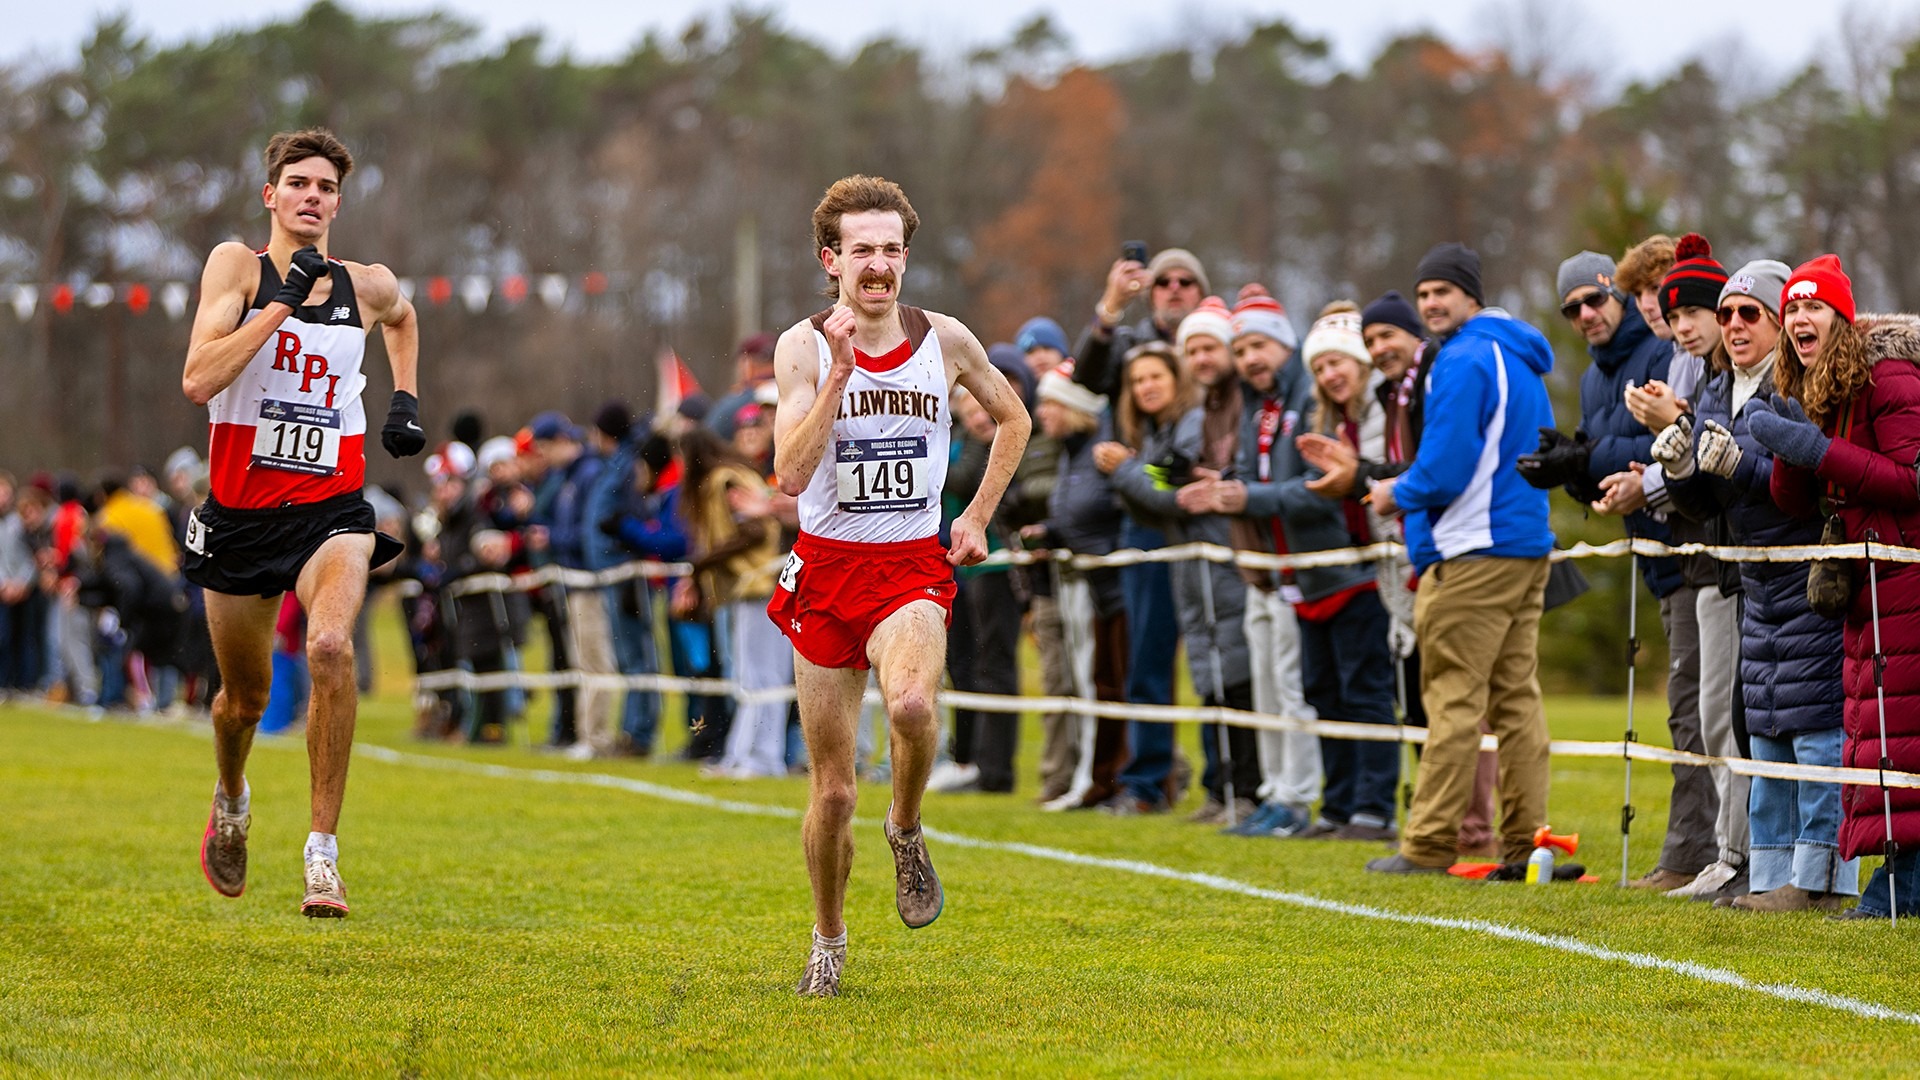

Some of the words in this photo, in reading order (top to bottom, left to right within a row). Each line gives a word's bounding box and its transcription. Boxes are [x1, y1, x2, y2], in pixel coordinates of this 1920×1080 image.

[271, 329, 341, 409] RPI
[848, 389, 940, 424] LAWRENCE
[270, 422, 324, 464] 119
[870, 441, 896, 449] MIDEAST
[897, 440, 918, 448] REGION
[851, 460, 914, 501] 149
[188, 519, 197, 544] 9
